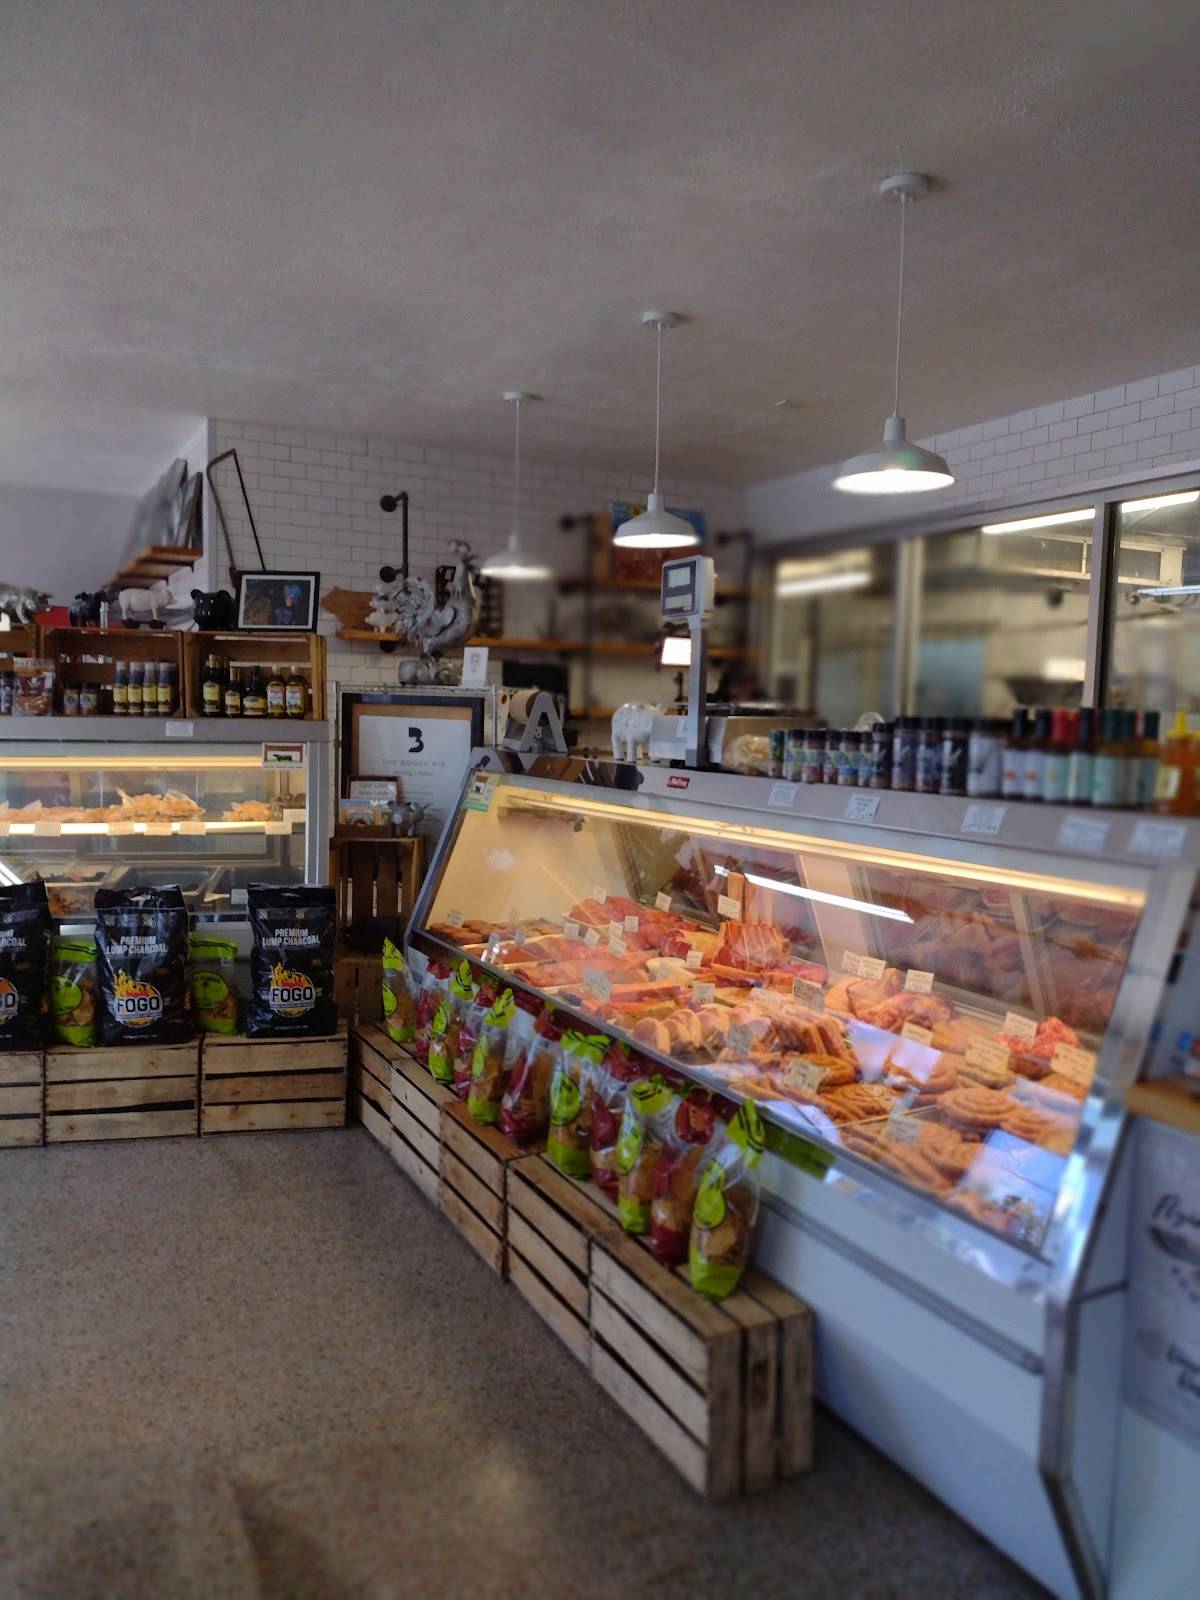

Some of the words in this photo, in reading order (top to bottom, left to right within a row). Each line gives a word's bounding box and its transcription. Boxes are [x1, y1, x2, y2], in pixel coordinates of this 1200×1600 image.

[275, 928, 308, 937] PREMIUM
[120, 936, 156, 945] PREMIUM
[262, 937, 282, 946] LUMP
[283, 935, 321, 946] CHARCOAL
[105, 945, 128, 955] LUMP
[128, 943, 168, 955] CHARCOAL
[272, 987, 313, 1002] FOGO
[117, 996, 160, 1013] FOGO
